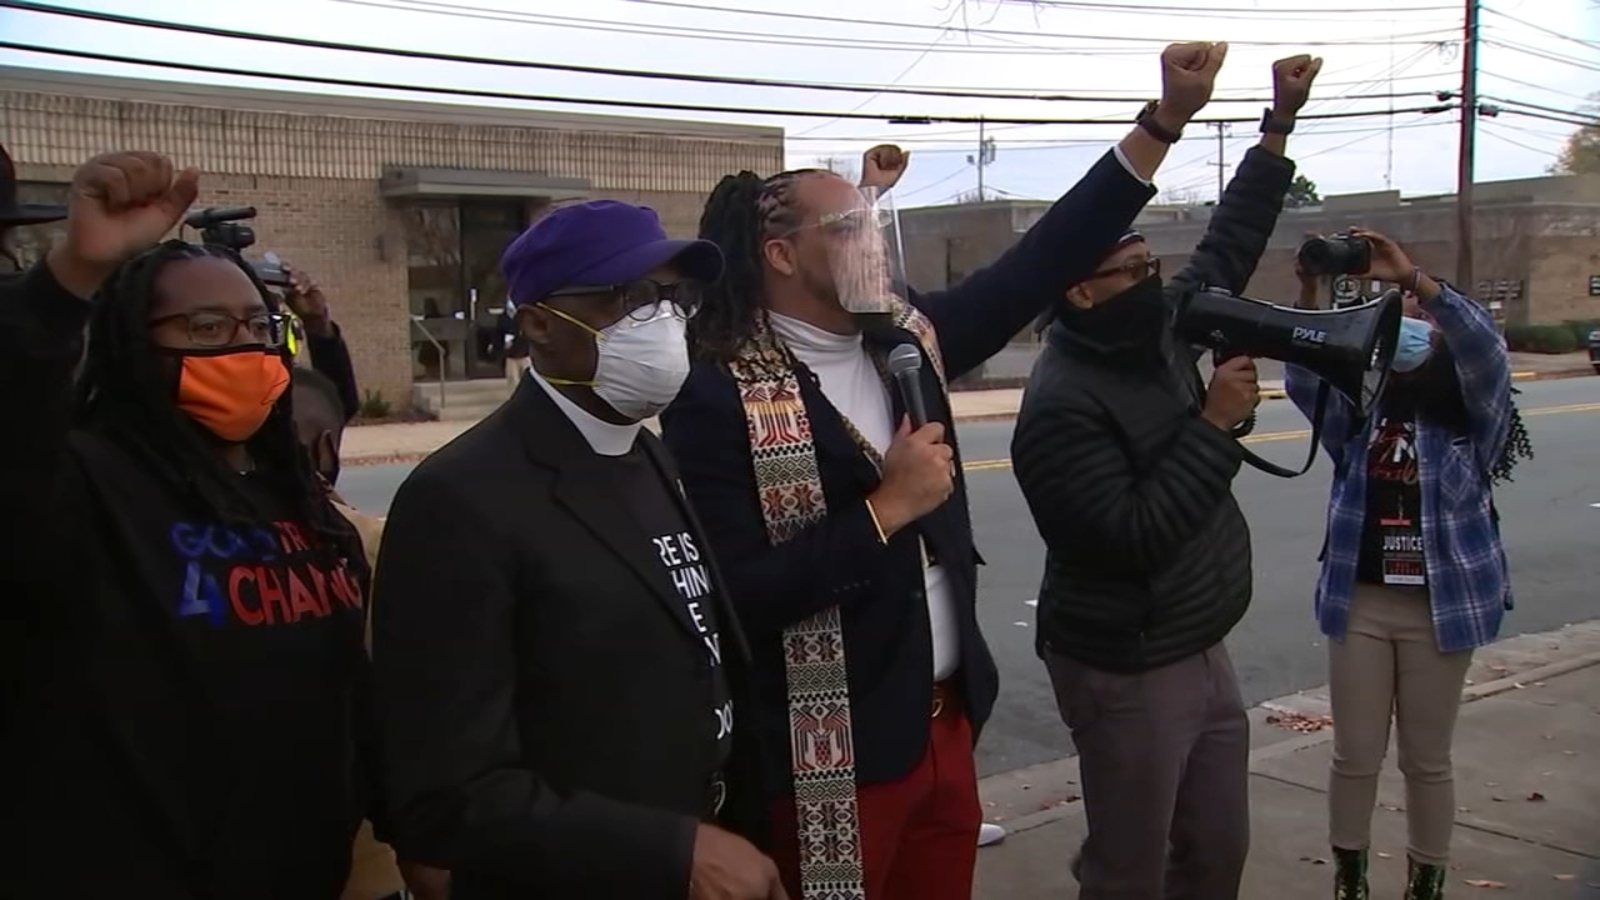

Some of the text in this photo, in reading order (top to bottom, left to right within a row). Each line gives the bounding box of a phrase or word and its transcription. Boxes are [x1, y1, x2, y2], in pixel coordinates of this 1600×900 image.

[1292, 326, 1327, 343] PYLE
[676, 531, 700, 562] IS
[1382, 535, 1423, 551] JUSTICE
